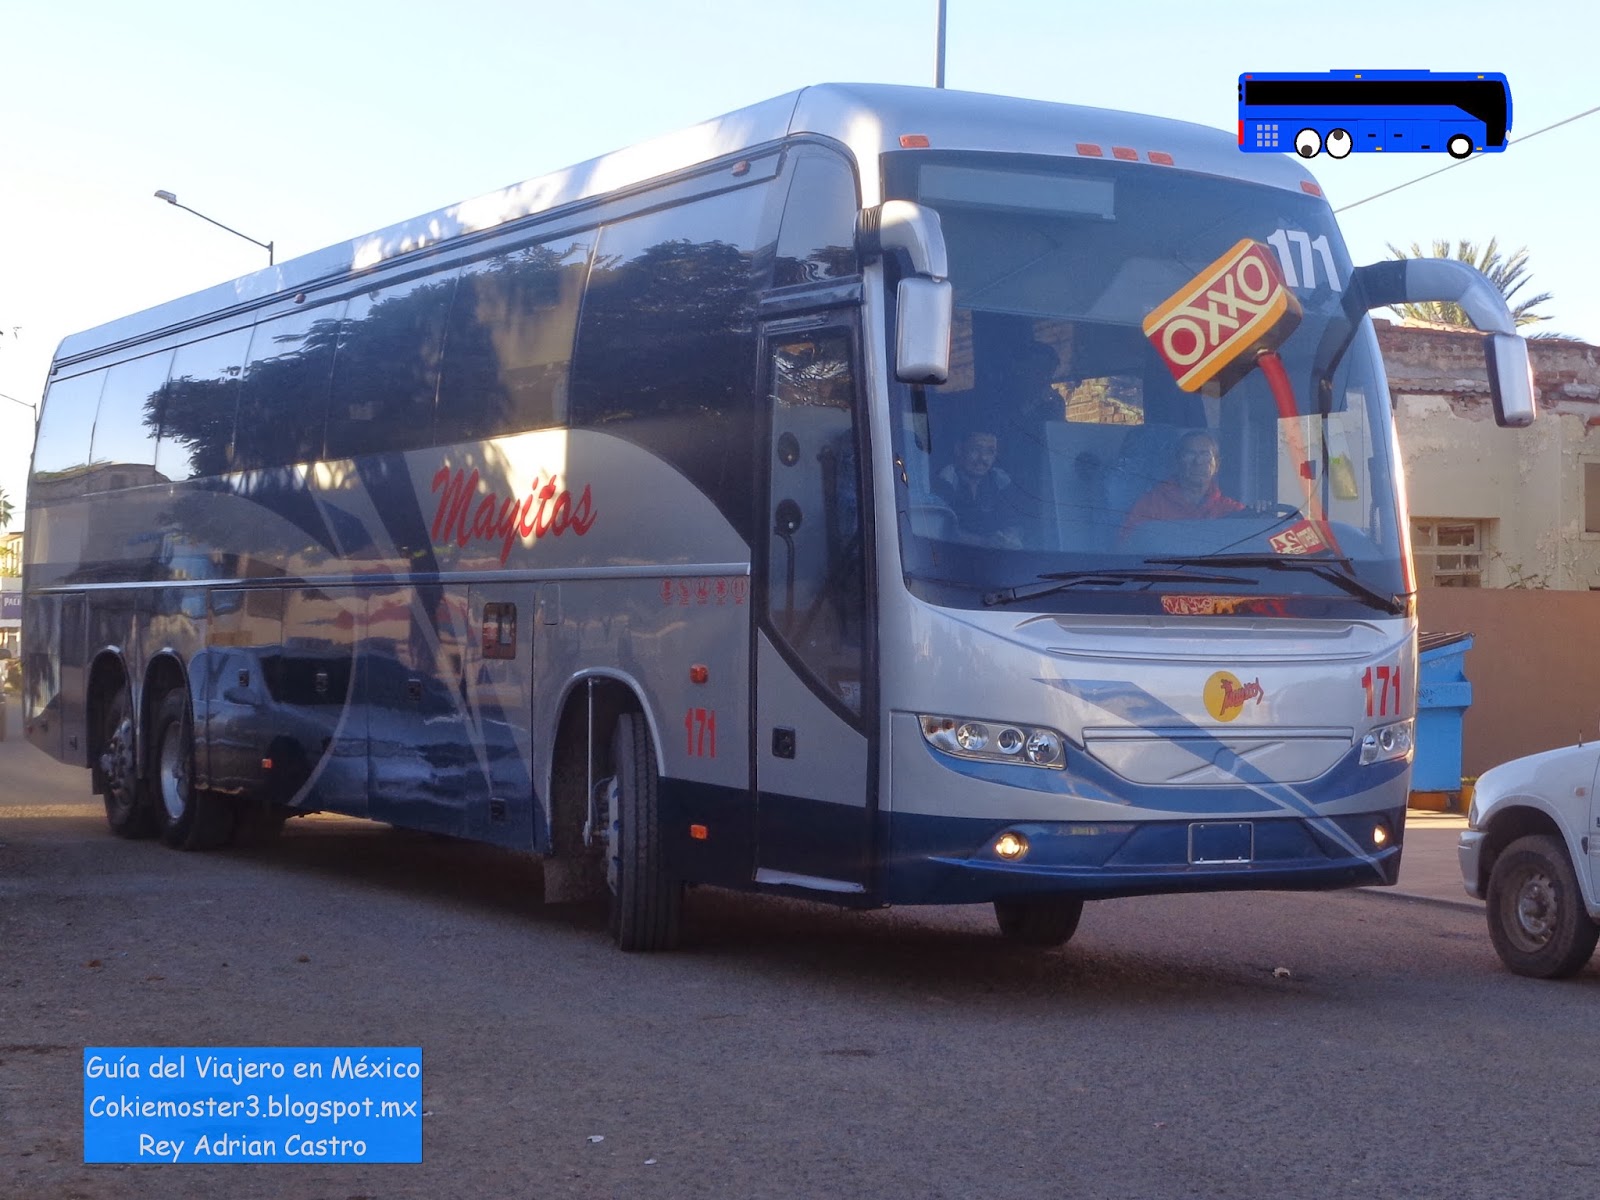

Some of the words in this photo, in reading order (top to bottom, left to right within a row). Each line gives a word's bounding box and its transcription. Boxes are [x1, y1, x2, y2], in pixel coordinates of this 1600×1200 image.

[1266, 228, 1343, 293] 171
[1162, 255, 1270, 366] OXXO
[431, 465, 598, 566] Mayitos
[1361, 665, 1400, 717] 171
[684, 707, 716, 759] 171
